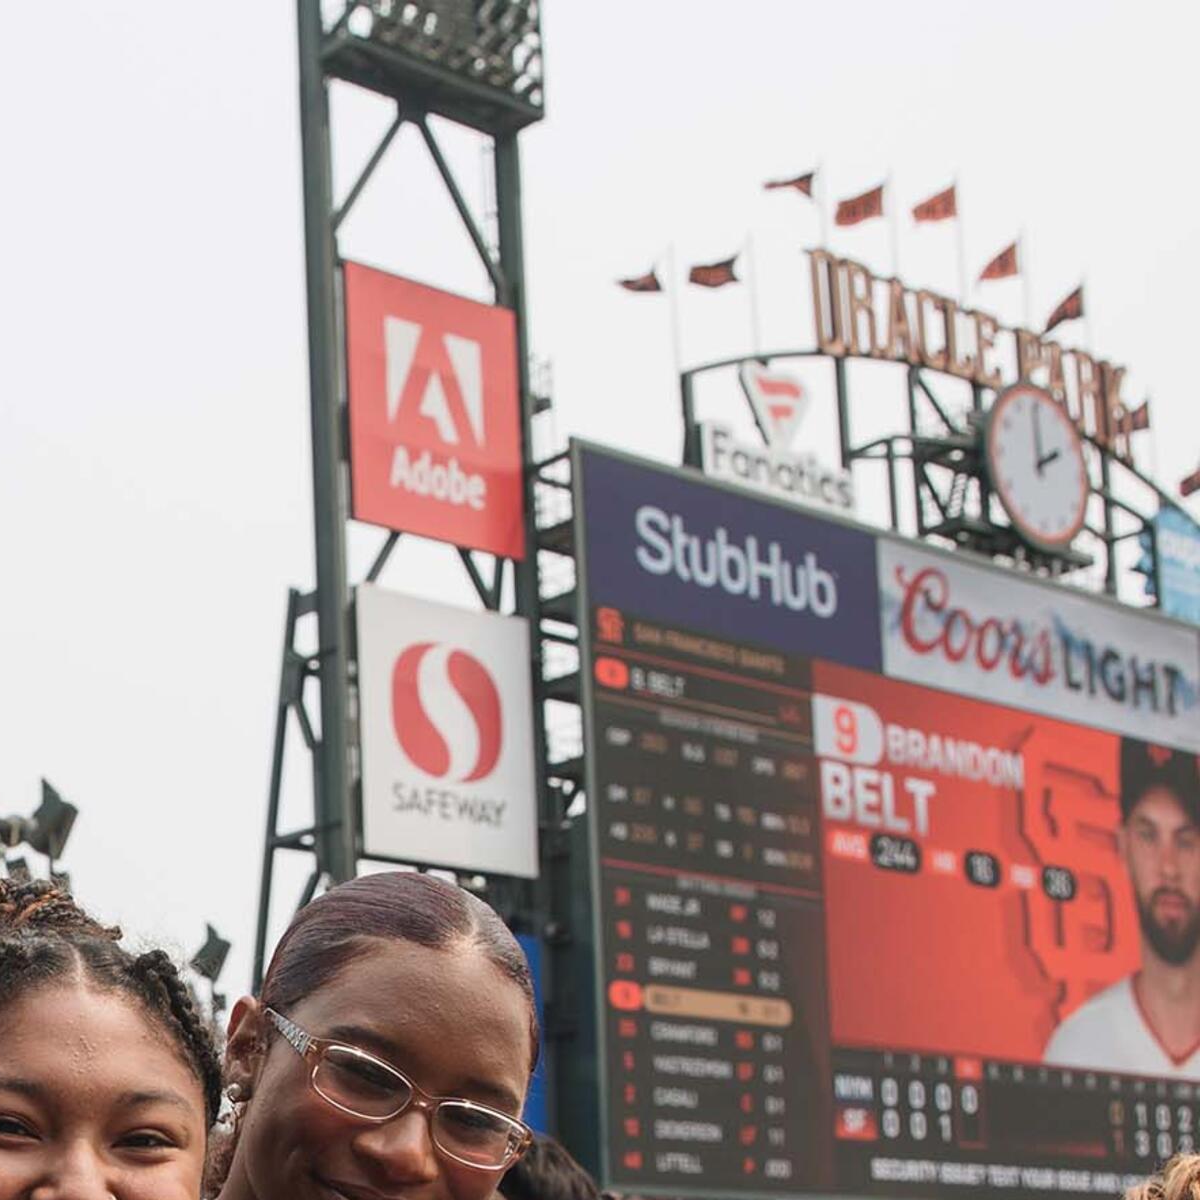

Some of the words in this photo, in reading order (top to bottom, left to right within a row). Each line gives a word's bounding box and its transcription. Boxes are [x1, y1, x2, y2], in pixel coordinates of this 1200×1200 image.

[809, 249, 1002, 391] ORACLE
[388, 445, 487, 510] Adobe
[708, 422, 856, 510] Fanatics
[635, 505, 838, 619] StubHub
[896, 567, 1057, 686] Coors
[1060, 630, 1185, 718] LIGHT
[833, 704, 859, 755] 9
[885, 724, 1025, 790] BRANDON
[391, 780, 507, 829] SAFEWAY
[820, 760, 936, 836] BELT
